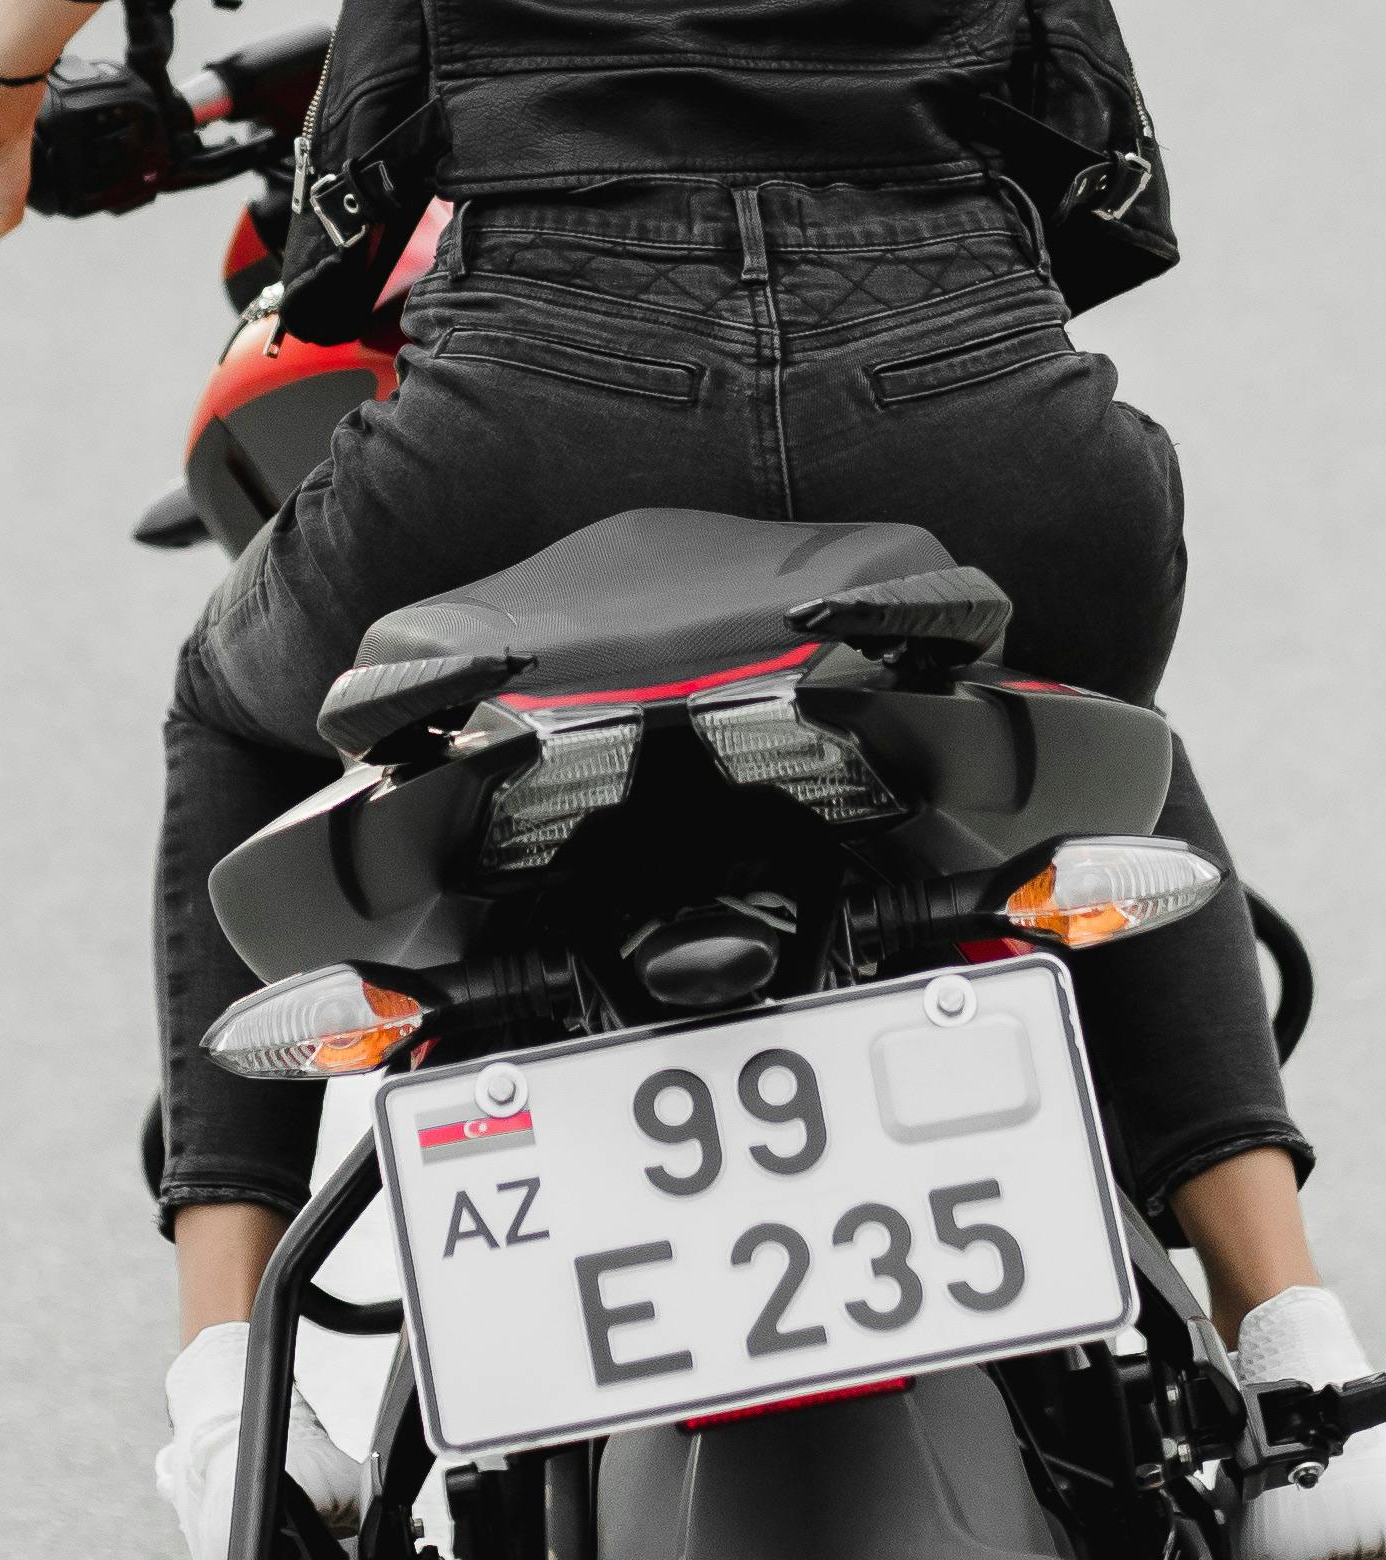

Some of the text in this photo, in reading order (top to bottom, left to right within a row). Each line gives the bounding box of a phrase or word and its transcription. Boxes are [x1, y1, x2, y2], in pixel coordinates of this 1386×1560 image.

[632, 1047, 828, 1198] 99
[443, 1176, 550, 1258] AZ
[573, 1179, 1026, 1387] E 235
